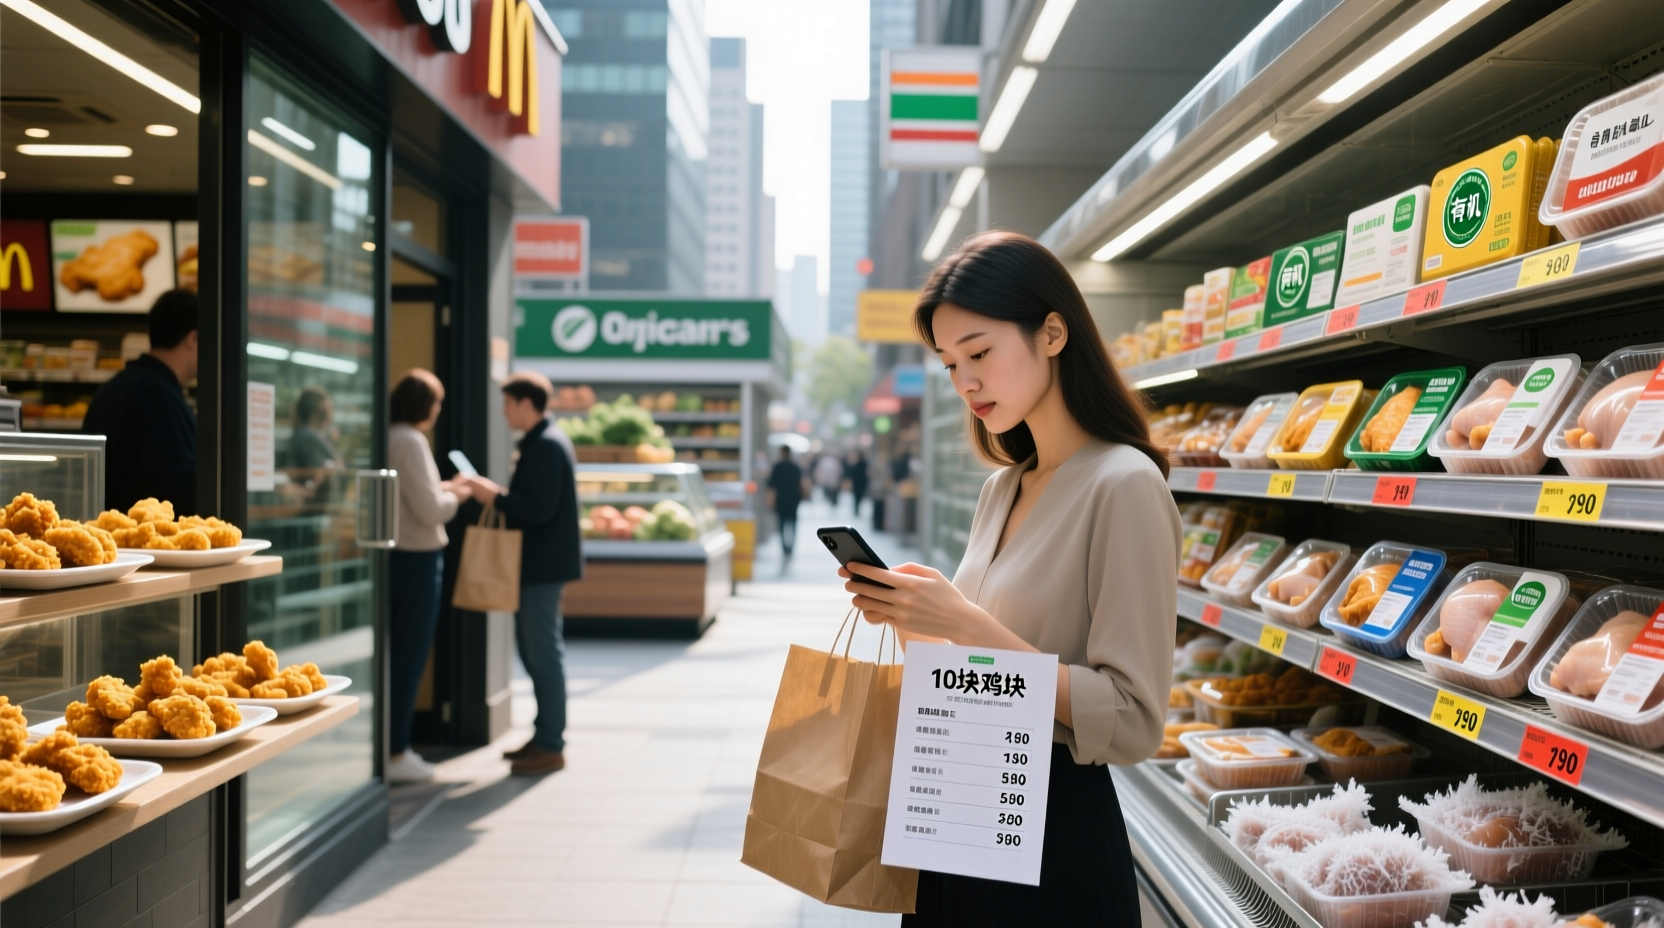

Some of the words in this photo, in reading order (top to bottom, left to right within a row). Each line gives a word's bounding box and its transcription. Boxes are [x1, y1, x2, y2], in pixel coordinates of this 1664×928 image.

[931, 667, 1027, 698] 10块鸡块
[1547, 746, 1579, 775] 790
